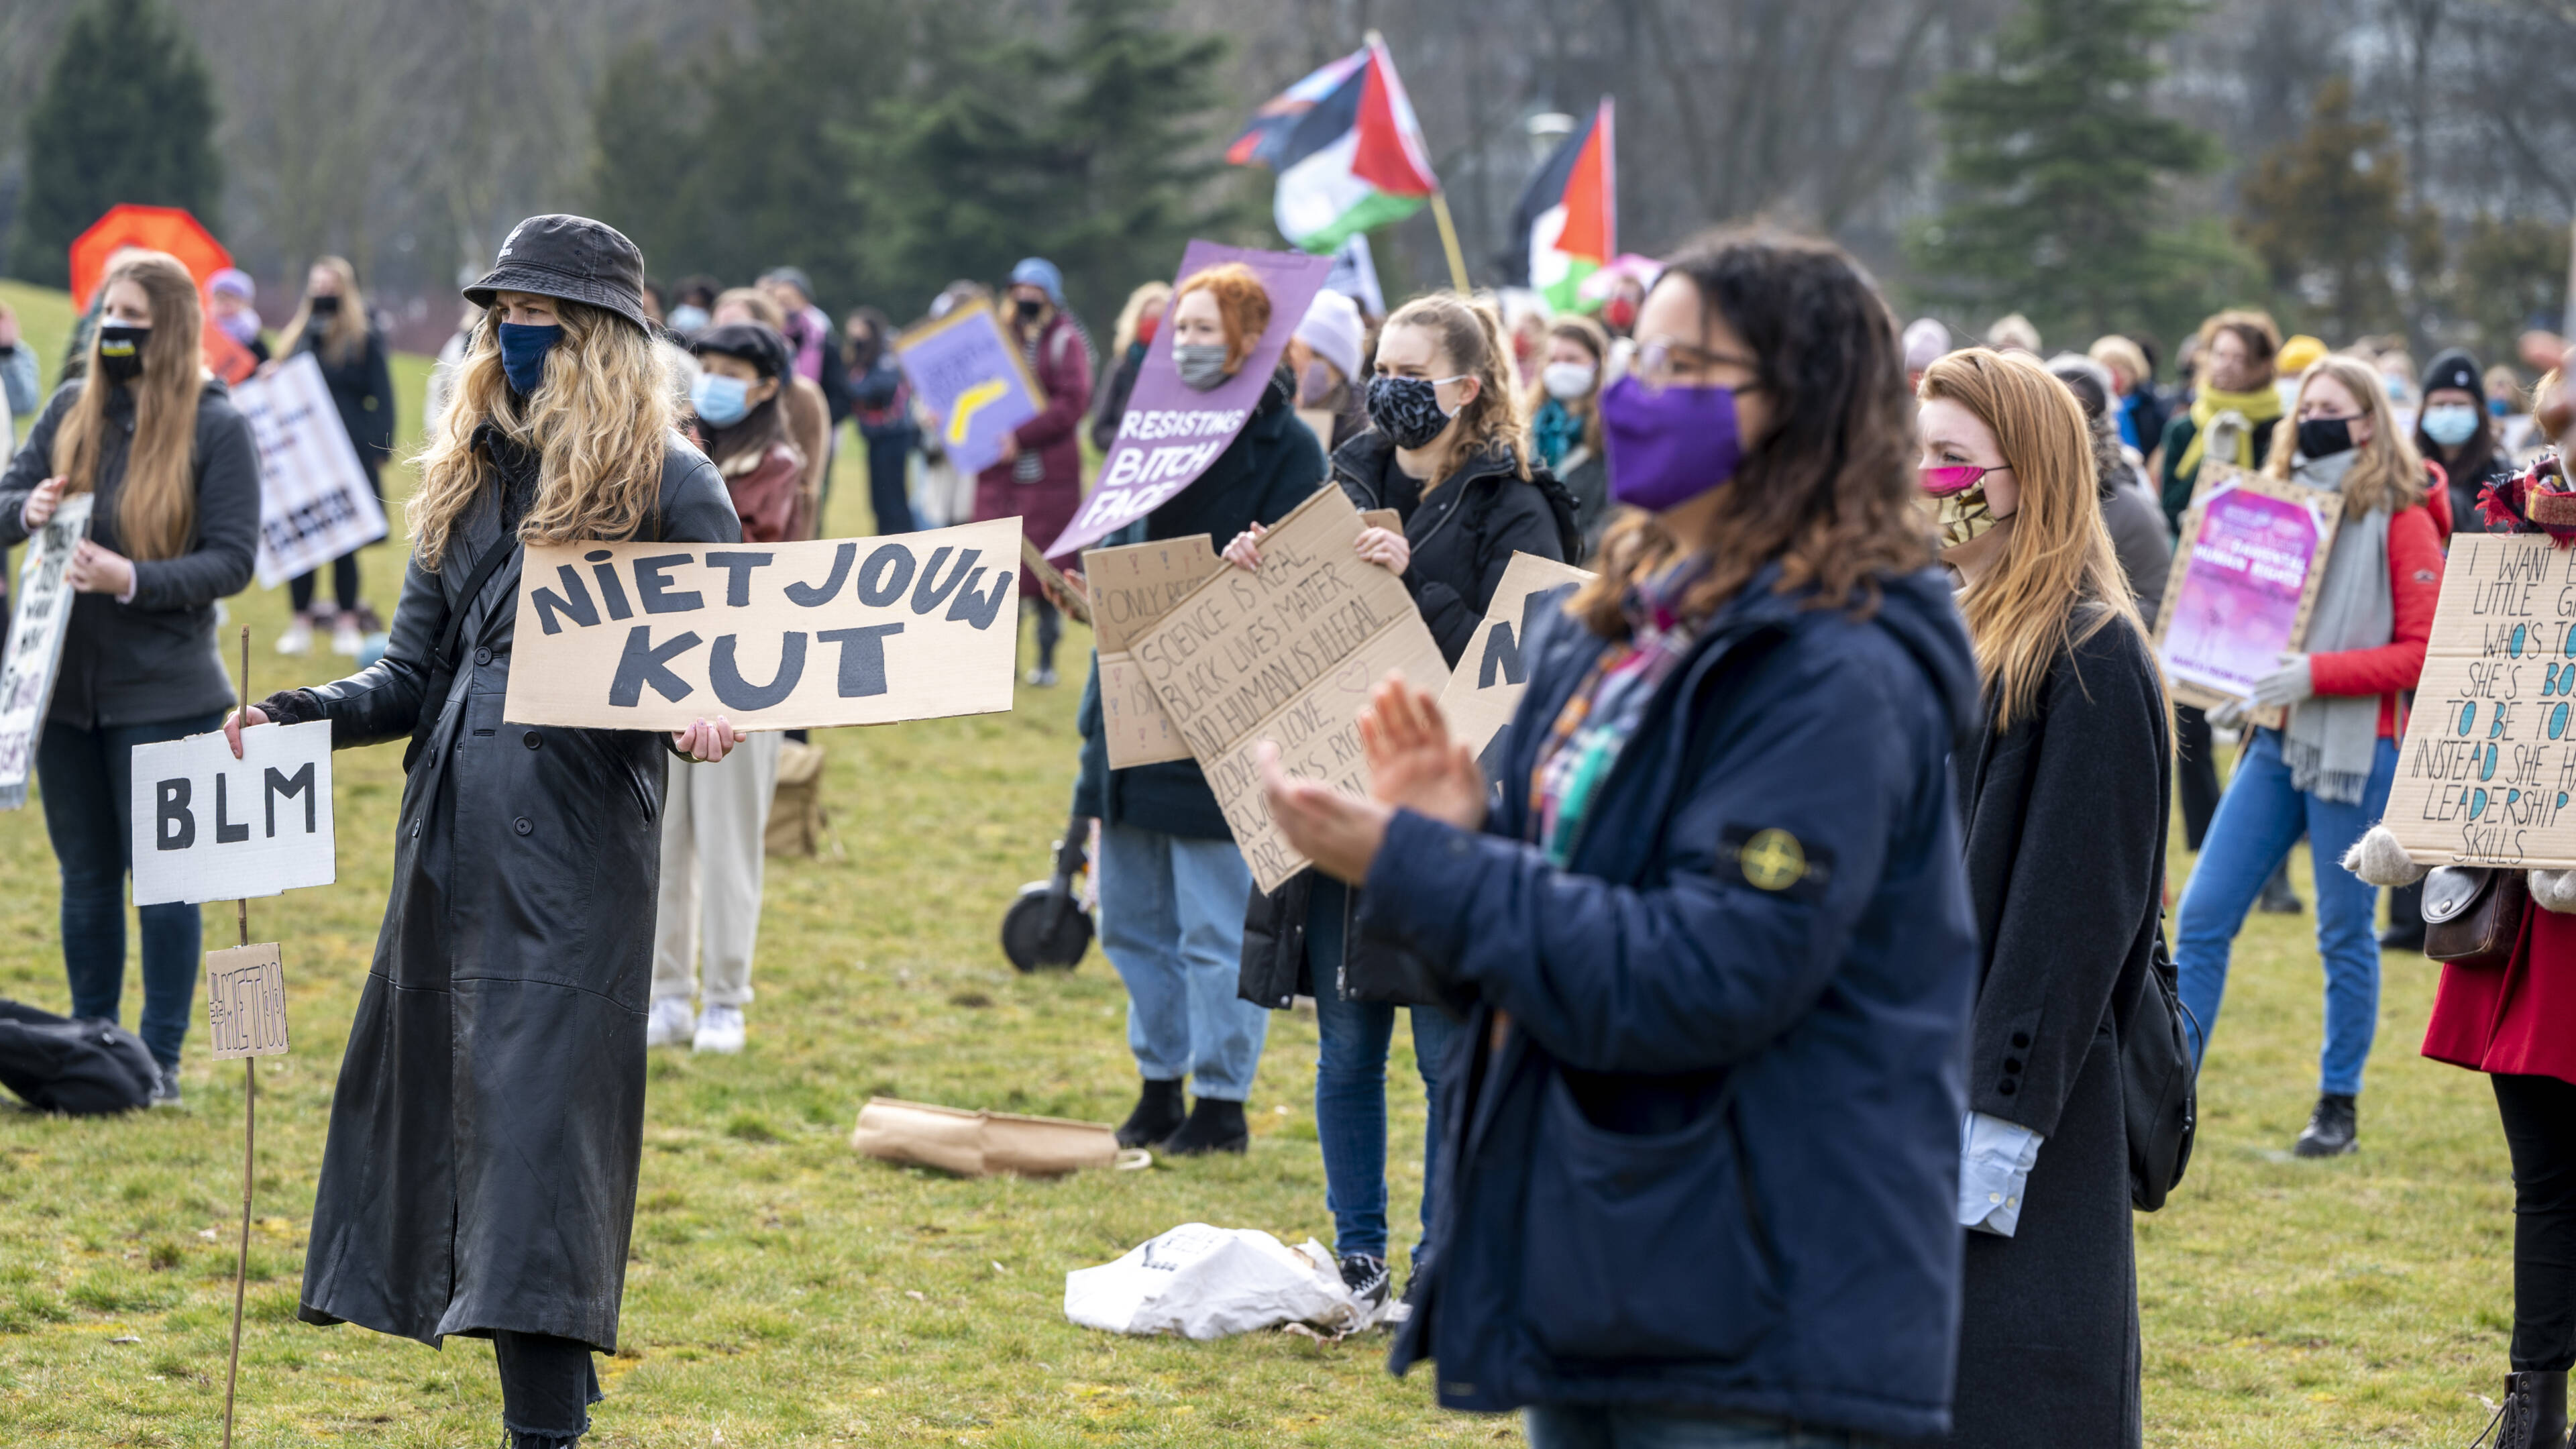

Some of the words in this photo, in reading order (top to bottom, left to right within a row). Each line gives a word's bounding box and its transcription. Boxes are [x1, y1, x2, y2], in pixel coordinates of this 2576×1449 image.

[1118, 409, 1246, 441] RESISTING
[1106, 439, 1221, 488] BITCH
[1079, 480, 1179, 530] FACE
[783, 542, 1014, 631] JOUW
[2469, 541, 2479, 576] I
[2498, 543, 2555, 583] WANT
[2473, 580, 2538, 616] LITTLE
[1141, 597, 1230, 681] SCIENCE
[1228, 578, 1256, 614] IS
[2483, 620, 2543, 660] WHO'S
[608, 621, 904, 712] KUT
[1161, 655, 1230, 724] BLACK
[1222, 616, 1281, 673] LIVES
[2460, 661, 2522, 700] SHE'S
[2539, 662, 2576, 697] BO
[1183, 714, 1227, 759] NO
[1216, 652, 1302, 738] HUMAN
[1289, 640, 1321, 680] IS
[2447, 700, 2477, 737] TO
[2486, 701, 2522, 741] BE
[1212, 745, 1262, 808] LOVE
[2412, 737, 2498, 783] INSTEAD
[2506, 744, 2550, 787] SHE
[156, 761, 316, 851] BLM
[1242, 751, 1328, 831] WON'S
[2422, 783, 2569, 828] LEADERSHIP
[1252, 837, 1293, 890] ARE
[2452, 823, 2527, 865] SKILLS
[209, 961, 284, 1051] #METOO
